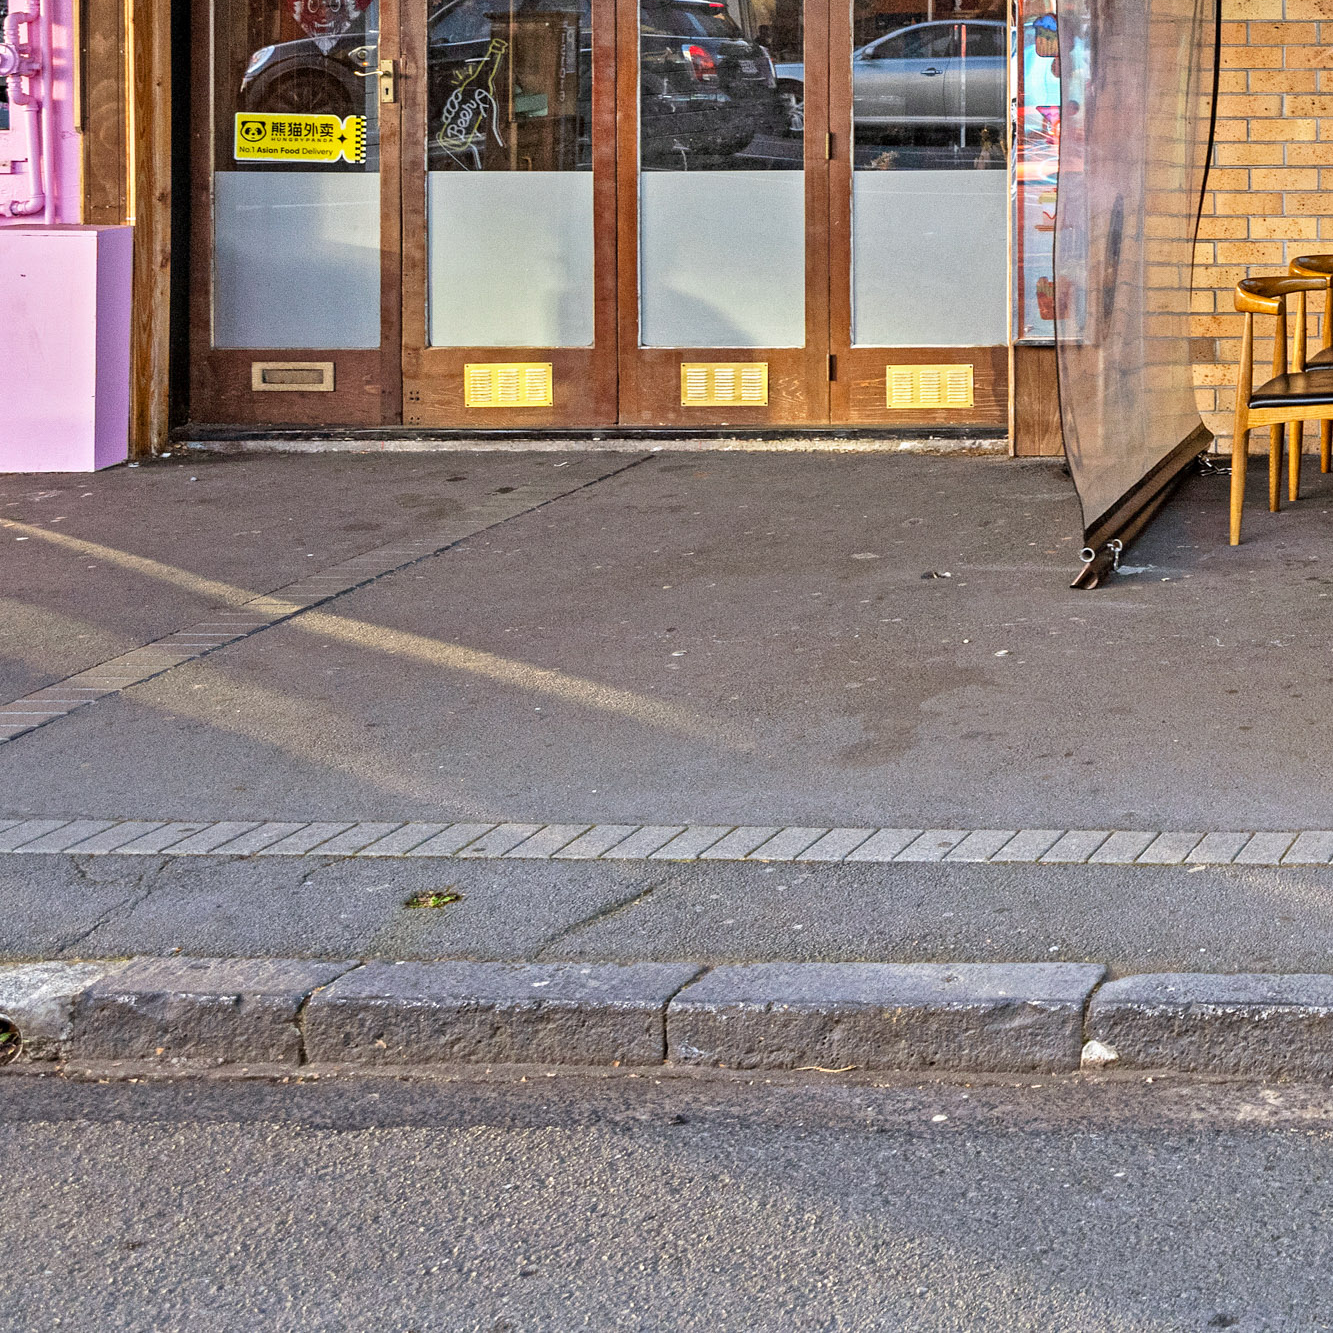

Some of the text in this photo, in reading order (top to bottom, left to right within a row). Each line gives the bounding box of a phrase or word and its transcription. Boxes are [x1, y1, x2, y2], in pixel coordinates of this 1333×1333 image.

[271, 122, 334, 137] 熊猫外卖
[256, 147, 279, 155] Asian
[280, 147, 300, 155] Food
[302, 148, 334, 156] Delivery
